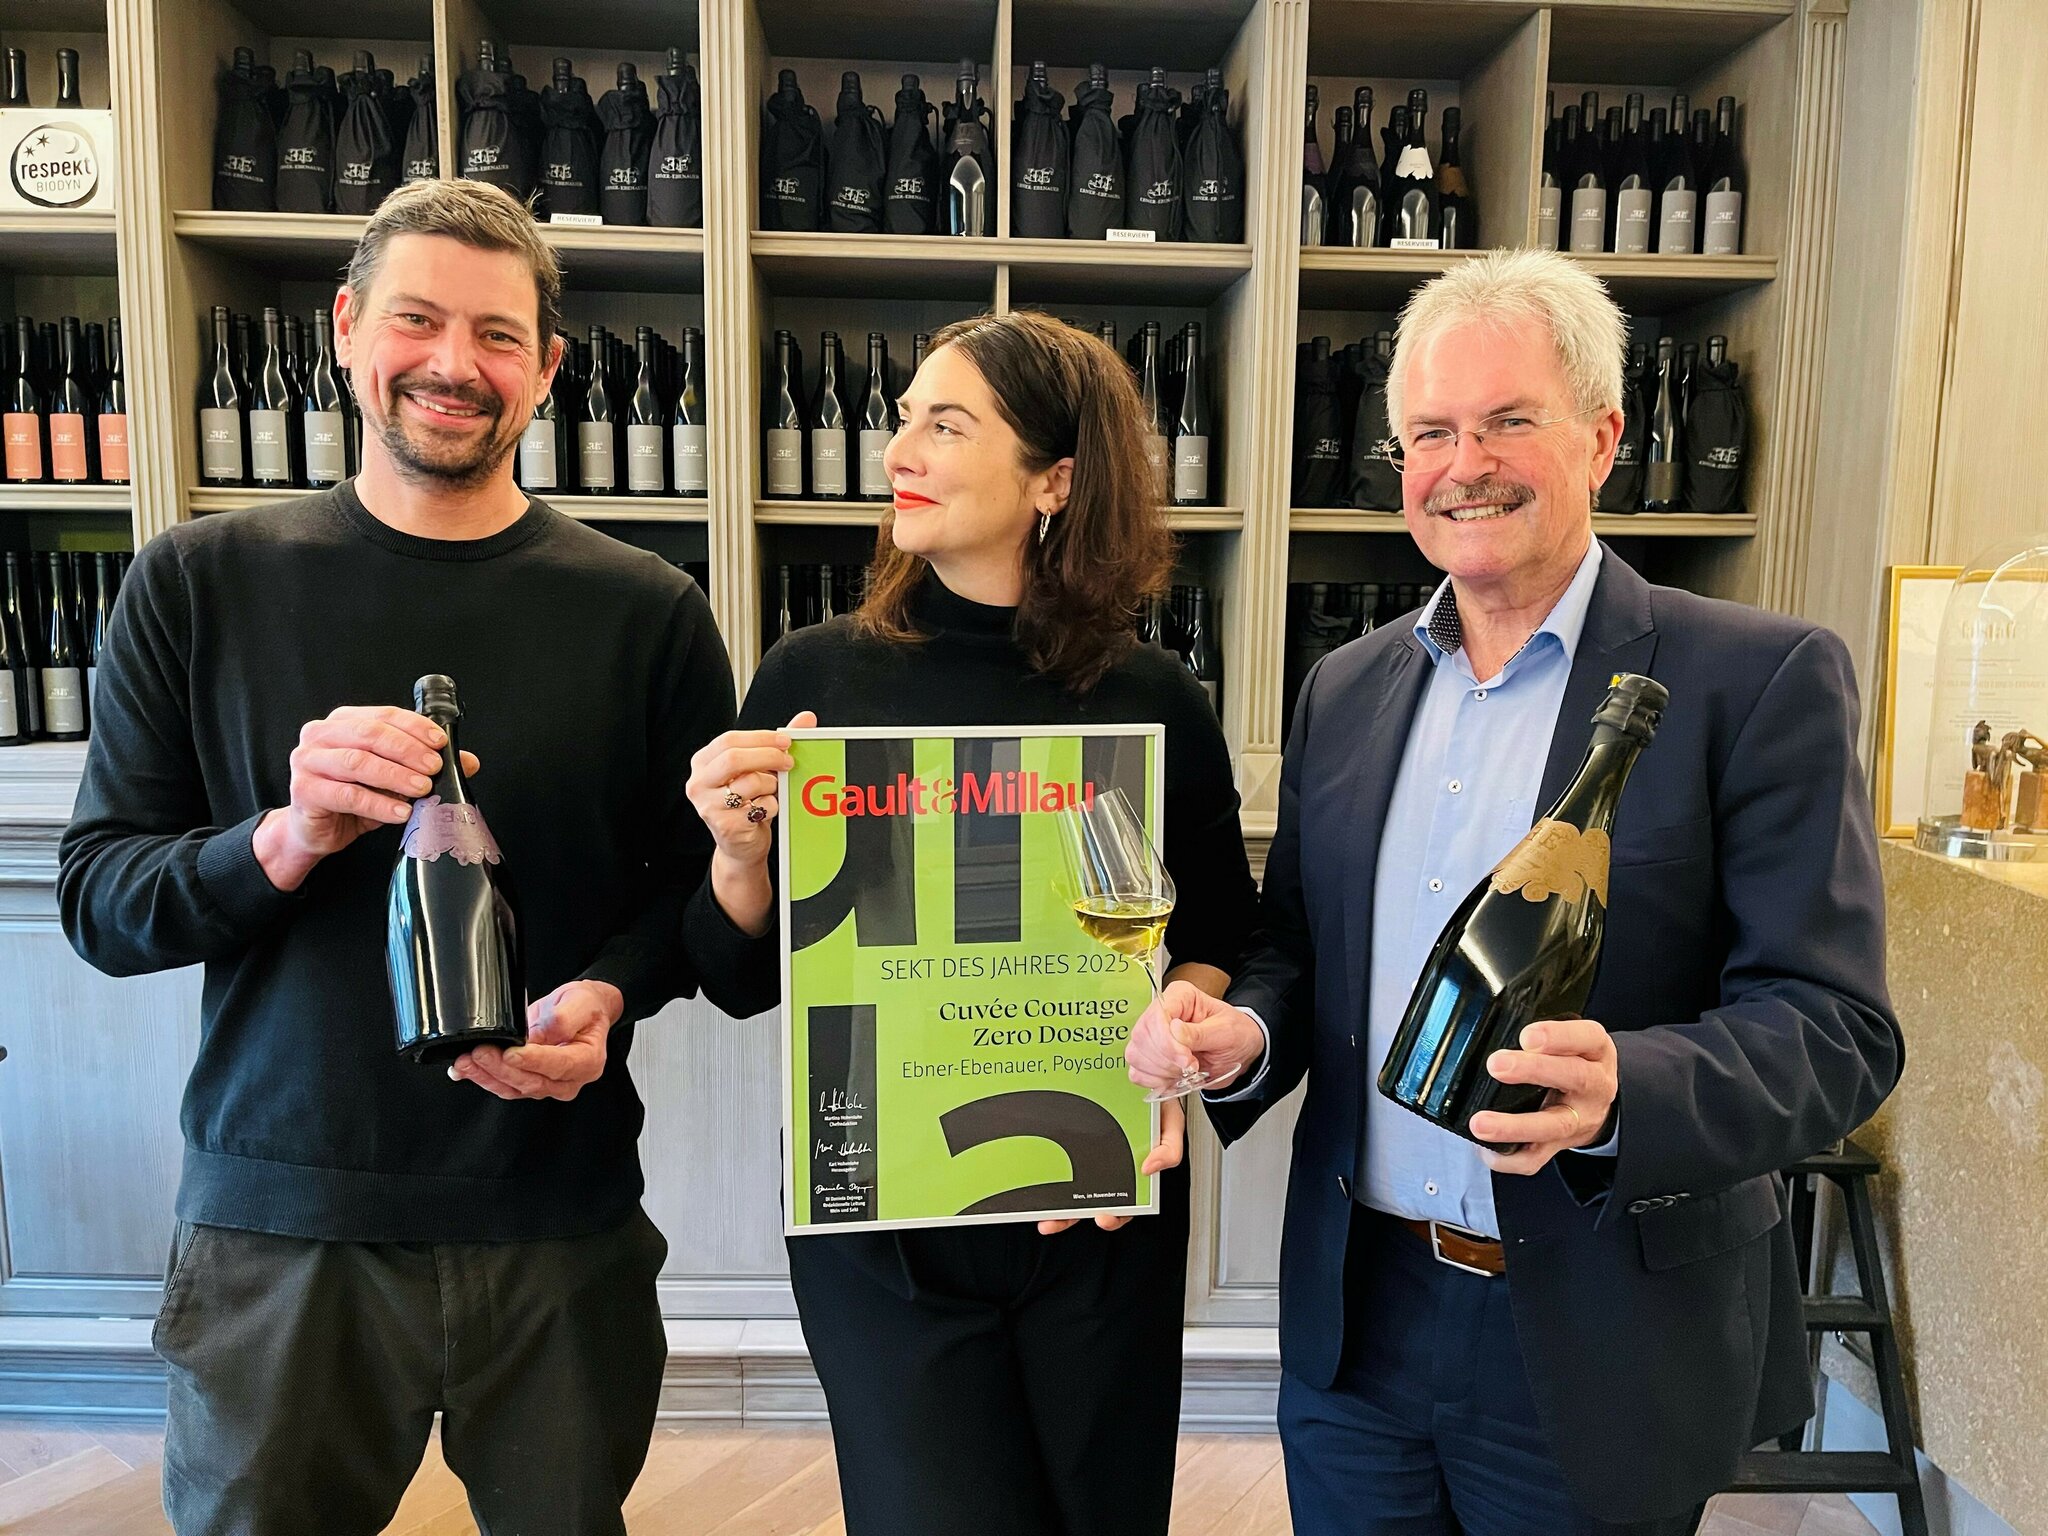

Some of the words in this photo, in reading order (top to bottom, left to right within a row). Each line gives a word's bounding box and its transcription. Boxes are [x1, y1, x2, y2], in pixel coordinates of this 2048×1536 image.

[21, 157, 91, 179] respekt
[36, 179, 81, 193] BIODYN
[1112, 230, 1150, 239] RESERVIERT
[1396, 239, 1434, 248] RESERVIERT
[801, 771, 1095, 817] Gault&Millau
[880, 958, 935, 981] SEKT
[942, 956, 985, 979] DES
[990, 954, 1070, 979] JAHRES
[1077, 953, 1129, 973] 2025
[939, 998, 1018, 1021] Cuvée
[1024, 999, 1129, 1020] Courage
[973, 1027, 1032, 1047] Zero
[1038, 1025, 1129, 1046] Dosage
[902, 1058, 1047, 1079] Ebner-Ebenauer,
